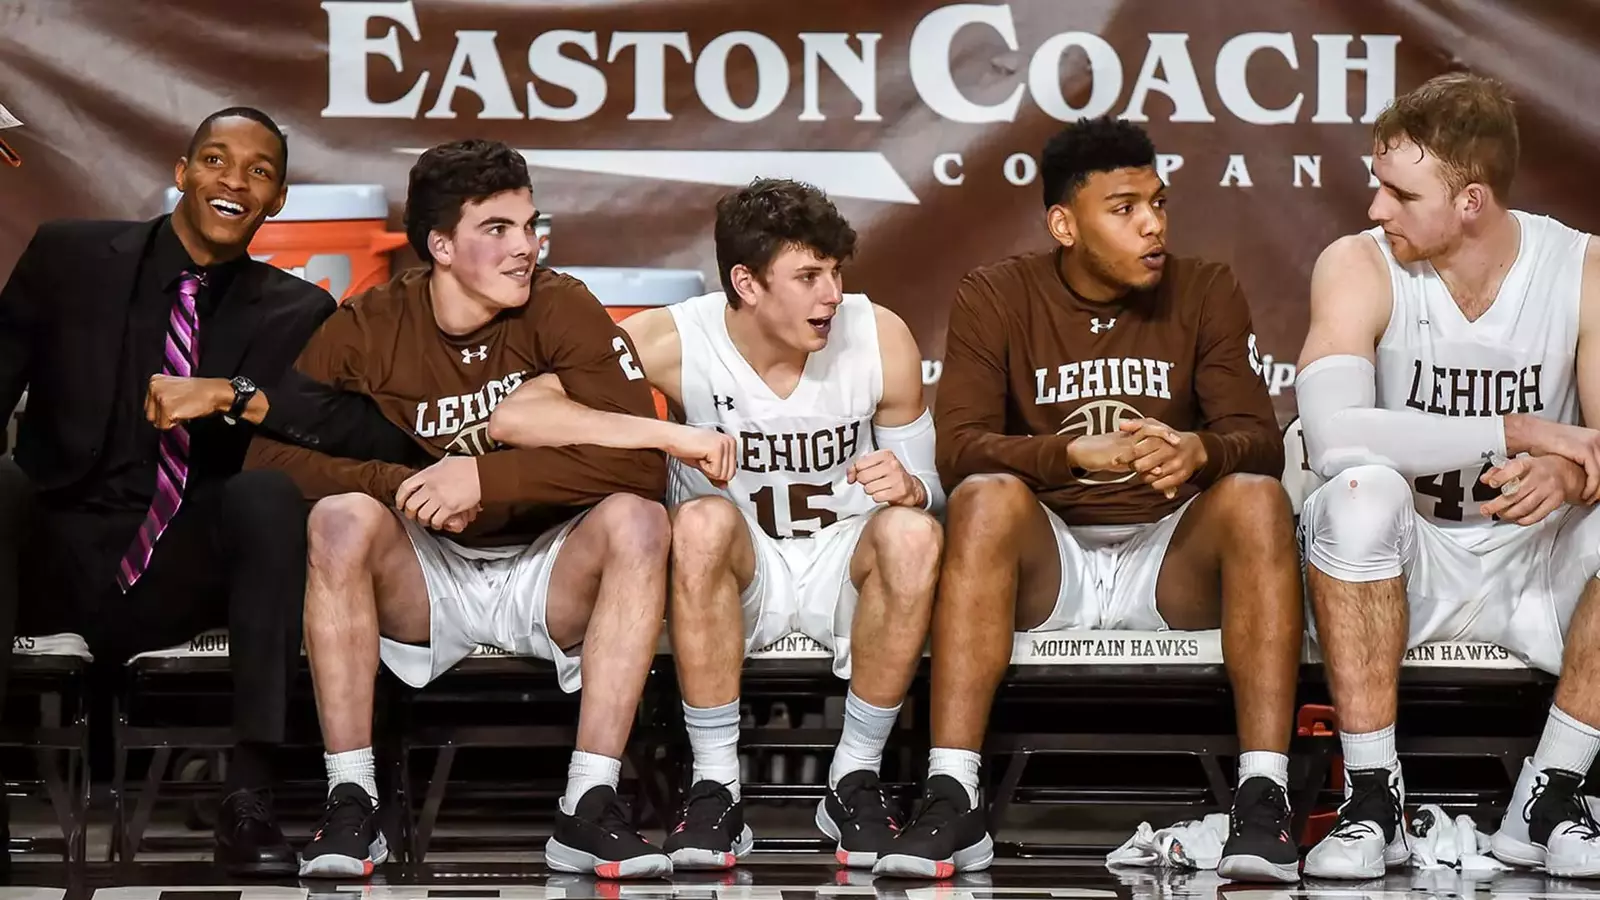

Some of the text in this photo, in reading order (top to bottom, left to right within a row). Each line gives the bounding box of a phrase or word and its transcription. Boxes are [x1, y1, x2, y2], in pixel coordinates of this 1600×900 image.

[320, 1, 1402, 125] EASTON COACH
[933, 153, 1380, 187] COPANY
[612, 336, 645, 381] 2
[1035, 358, 1172, 405] LEHIGH
[1405, 359, 1544, 418] LEHIGH
[734, 420, 860, 474] EHIGH
[750, 481, 838, 540] 15
[1030, 639, 1199, 657] MOUNTAIN HAWKS
[1440, 644, 1509, 661] HAWKS
